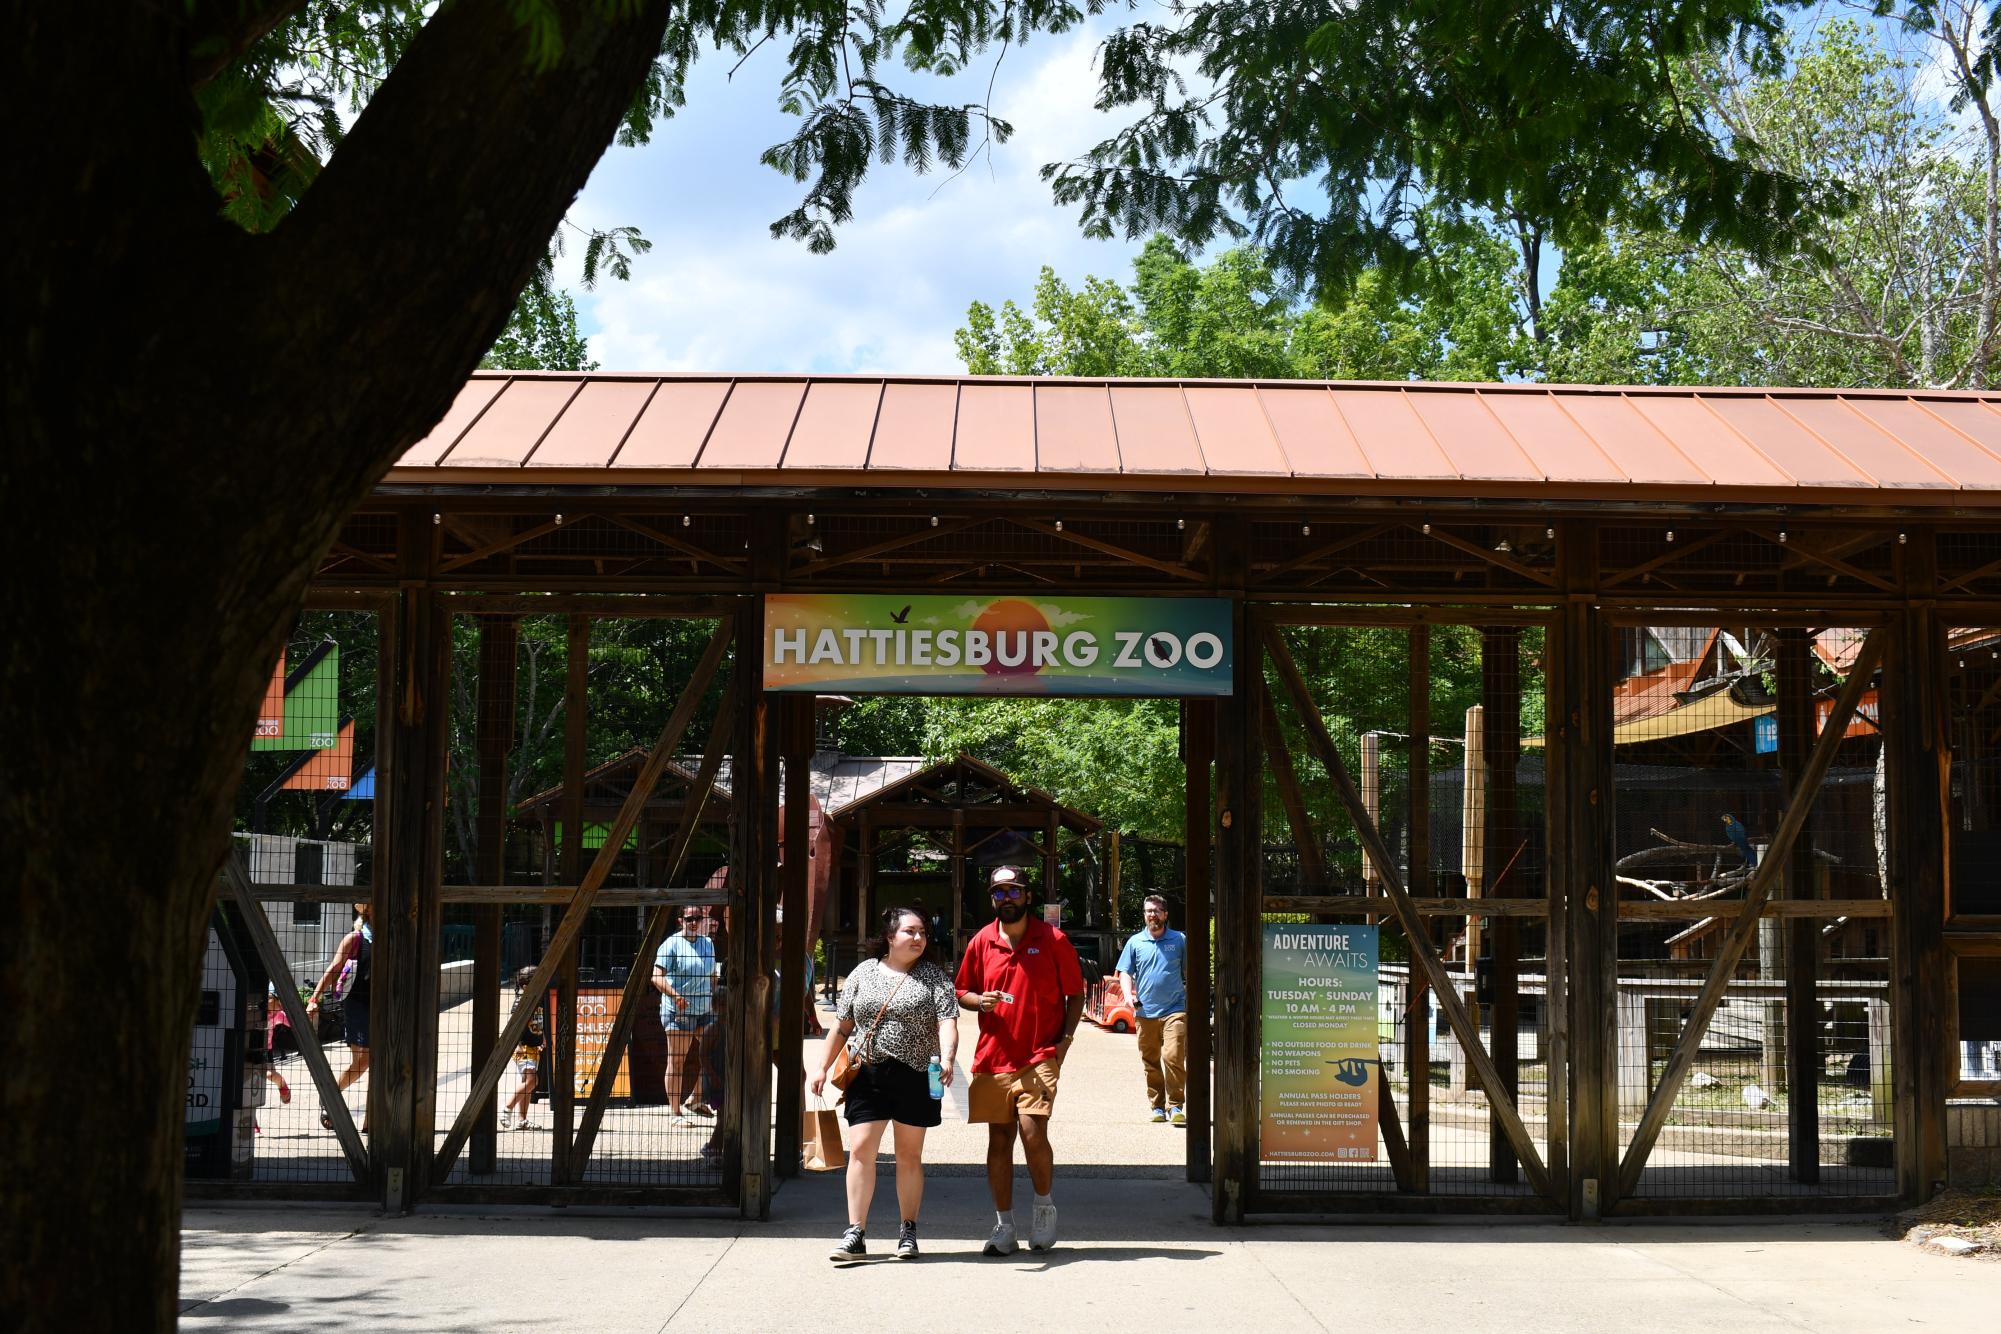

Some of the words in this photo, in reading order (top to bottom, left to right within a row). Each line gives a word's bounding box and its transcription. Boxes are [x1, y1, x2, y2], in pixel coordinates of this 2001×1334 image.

[773, 628, 1099, 668] HATTIESBURG
[1112, 631, 1224, 669] ZOO
[310, 737, 333, 747] ZOO
[1273, 934, 1349, 950] ADVENTURE
[1303, 952, 1368, 969] AWAITS
[1298, 977, 1343, 987] HOURS:
[1267, 990, 1317, 1000] TUESDAY
[1326, 991, 1373, 1001] SUNDAY
[576, 1003, 607, 1017] OO
[1286, 1003, 1298, 1013] 10
[1300, 1003, 1319, 1013] AM
[1328, 1004, 1336, 1013] 4
[1339, 1004, 1356, 1014] PM
